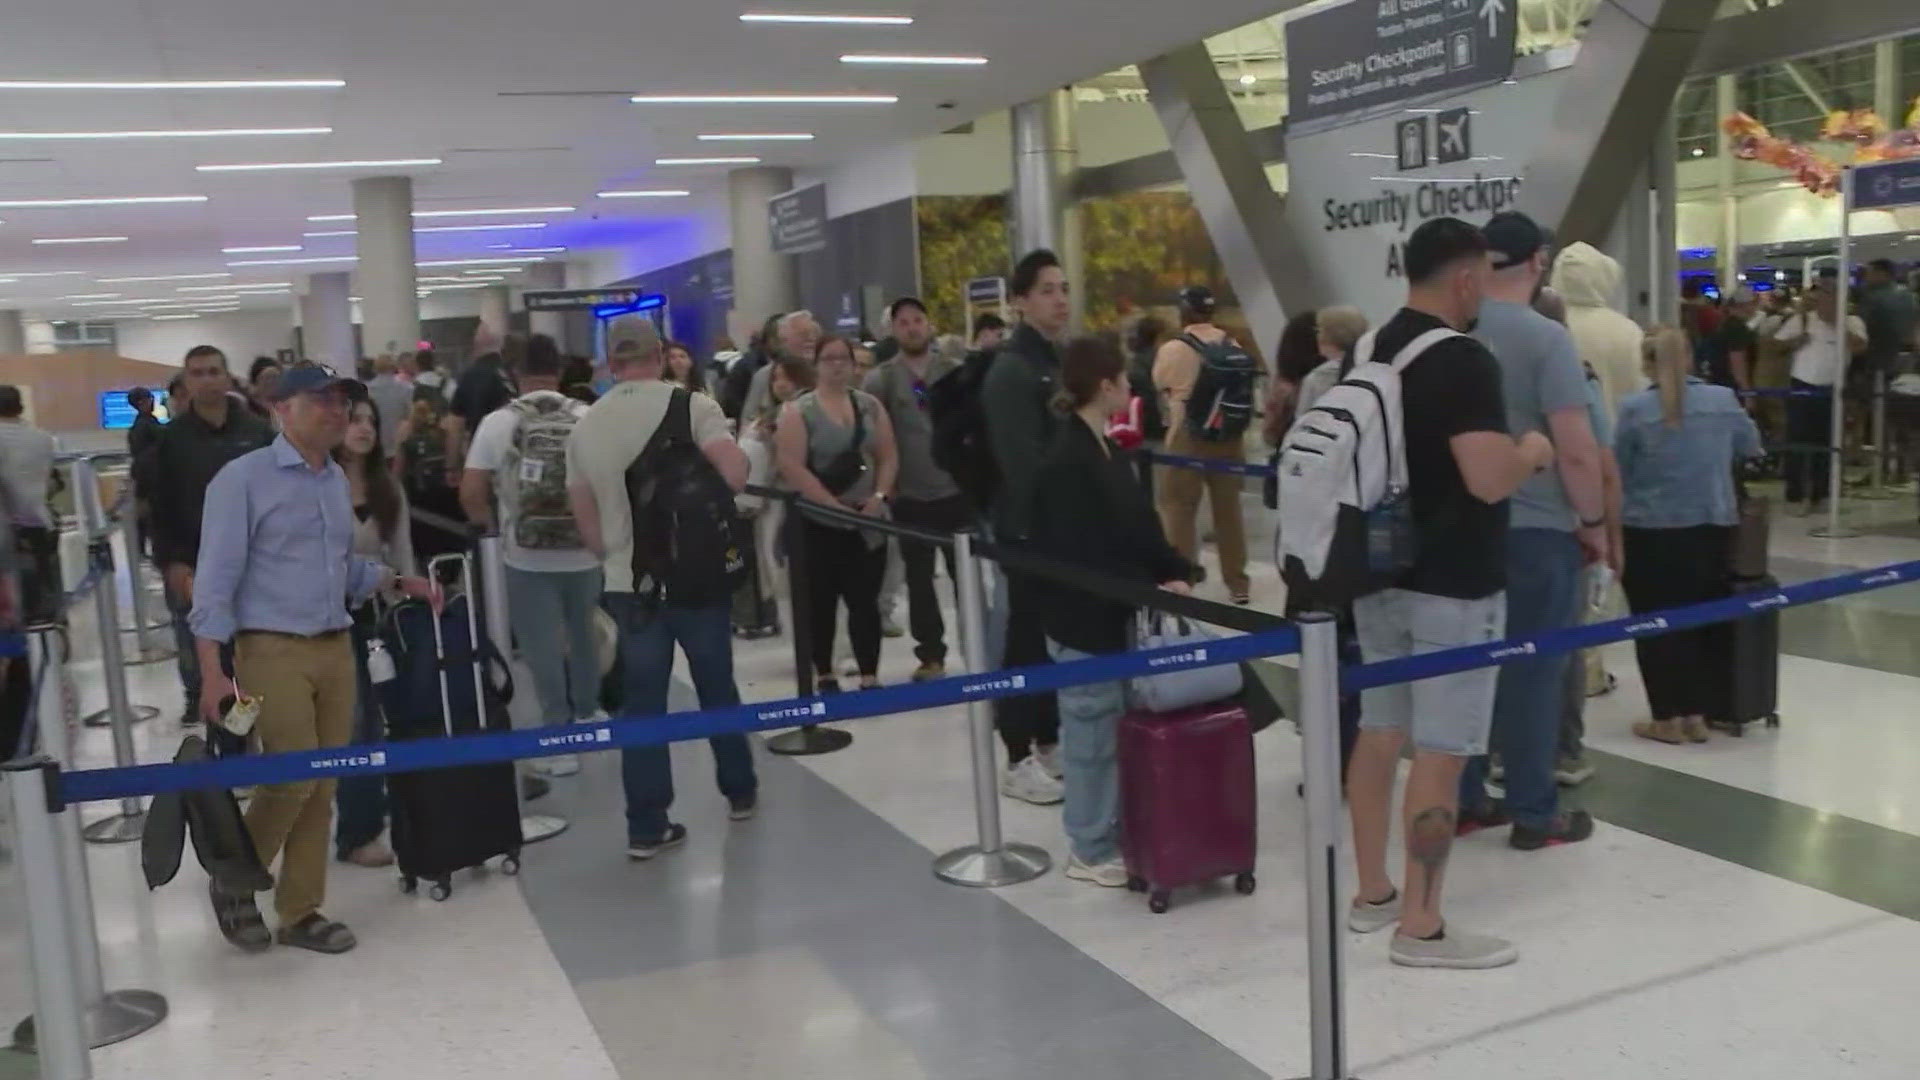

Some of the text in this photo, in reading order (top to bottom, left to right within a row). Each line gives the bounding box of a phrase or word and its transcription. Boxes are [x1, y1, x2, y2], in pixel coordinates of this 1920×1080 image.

[1310, 61, 1363, 87] Security
[1364, 38, 1445, 73] Checkpoint
[1323, 189, 1410, 232] Security
[961, 679, 1011, 693] UNITED
[757, 706, 811, 721] UNITED
[538, 732, 595, 746] UNITED
[310, 756, 369, 769] UNITED
